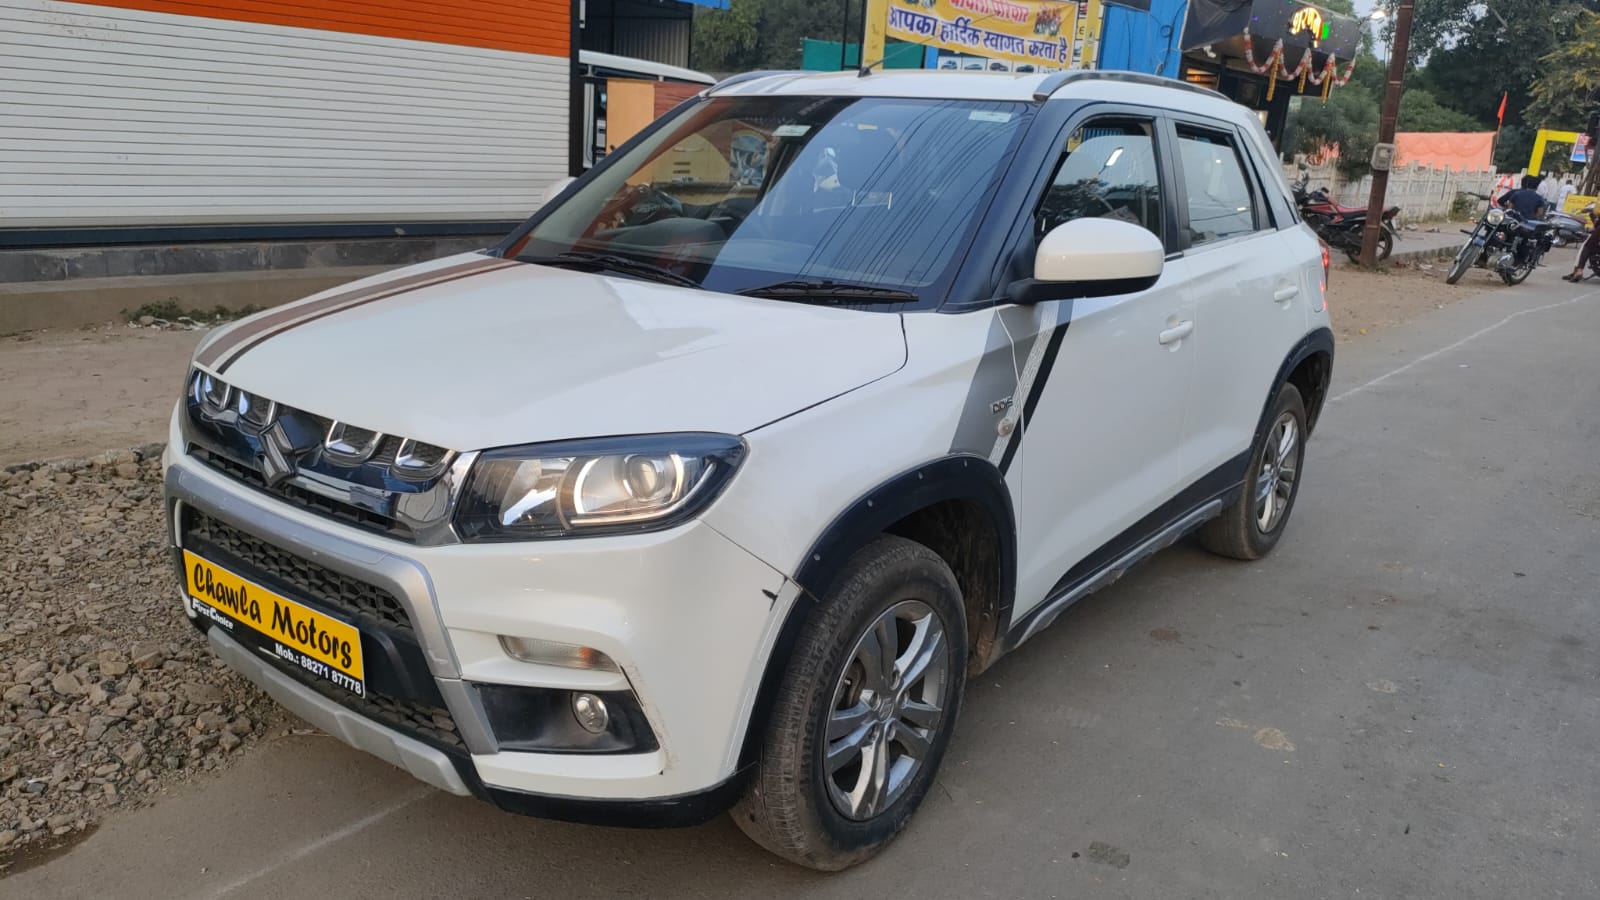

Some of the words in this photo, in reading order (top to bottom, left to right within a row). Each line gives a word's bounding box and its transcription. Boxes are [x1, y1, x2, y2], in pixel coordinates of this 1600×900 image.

[889, 7, 938, 36] आपका
[940, 16, 981, 46] हार्दिक
[983, 31, 1025, 54] स्वागत
[1028, 39, 1057, 59] करता
[1058, 36, 1068, 63] है
[193, 563, 262, 624] Chawla
[271, 601, 353, 669] Motors
[274, 643, 300, 665] Mob.:
[300, 655, 329, 678] 88271
[331, 670, 362, 694] 87778
